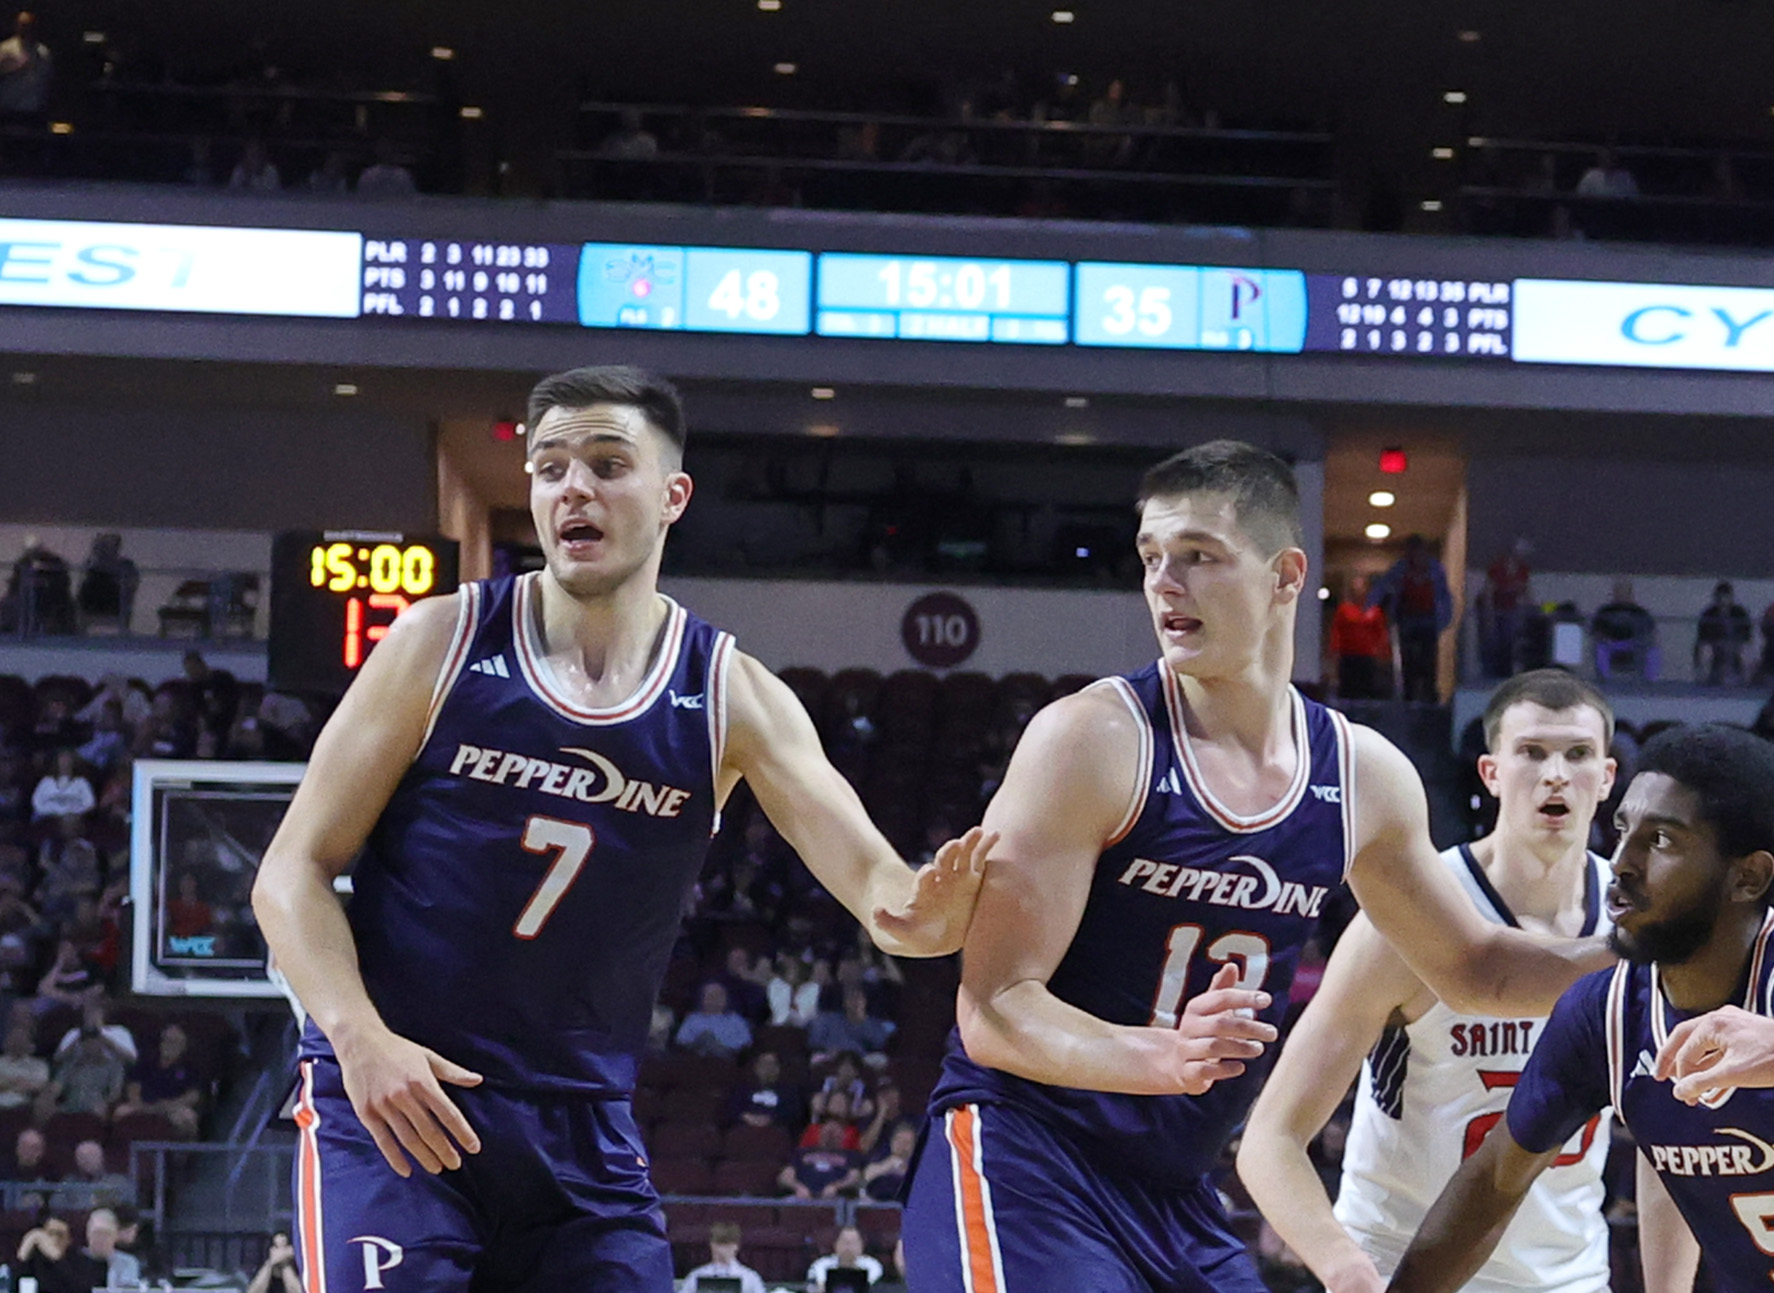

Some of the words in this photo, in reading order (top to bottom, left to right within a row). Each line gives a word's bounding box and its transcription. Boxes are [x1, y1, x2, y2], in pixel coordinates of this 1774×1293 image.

[472, 244, 494, 265] 11
[443, 270, 465, 291] 11
[526, 273, 547, 294] 11
[708, 268, 780, 321] 48
[879, 260, 1011, 309] 15:01
[448, 296, 459, 317] 1
[530, 300, 541, 321] 1
[1101, 285, 1172, 336] 35
[1367, 329, 1380, 350] 1
[310, 543, 434, 594] 15:00
[917, 614, 967, 647] 110
[449, 744, 690, 818] PEPPERDINE
[513, 813, 596, 940] 7
[1450, 1020, 1535, 1057] SAINT
[346, 1235, 403, 1291] P
